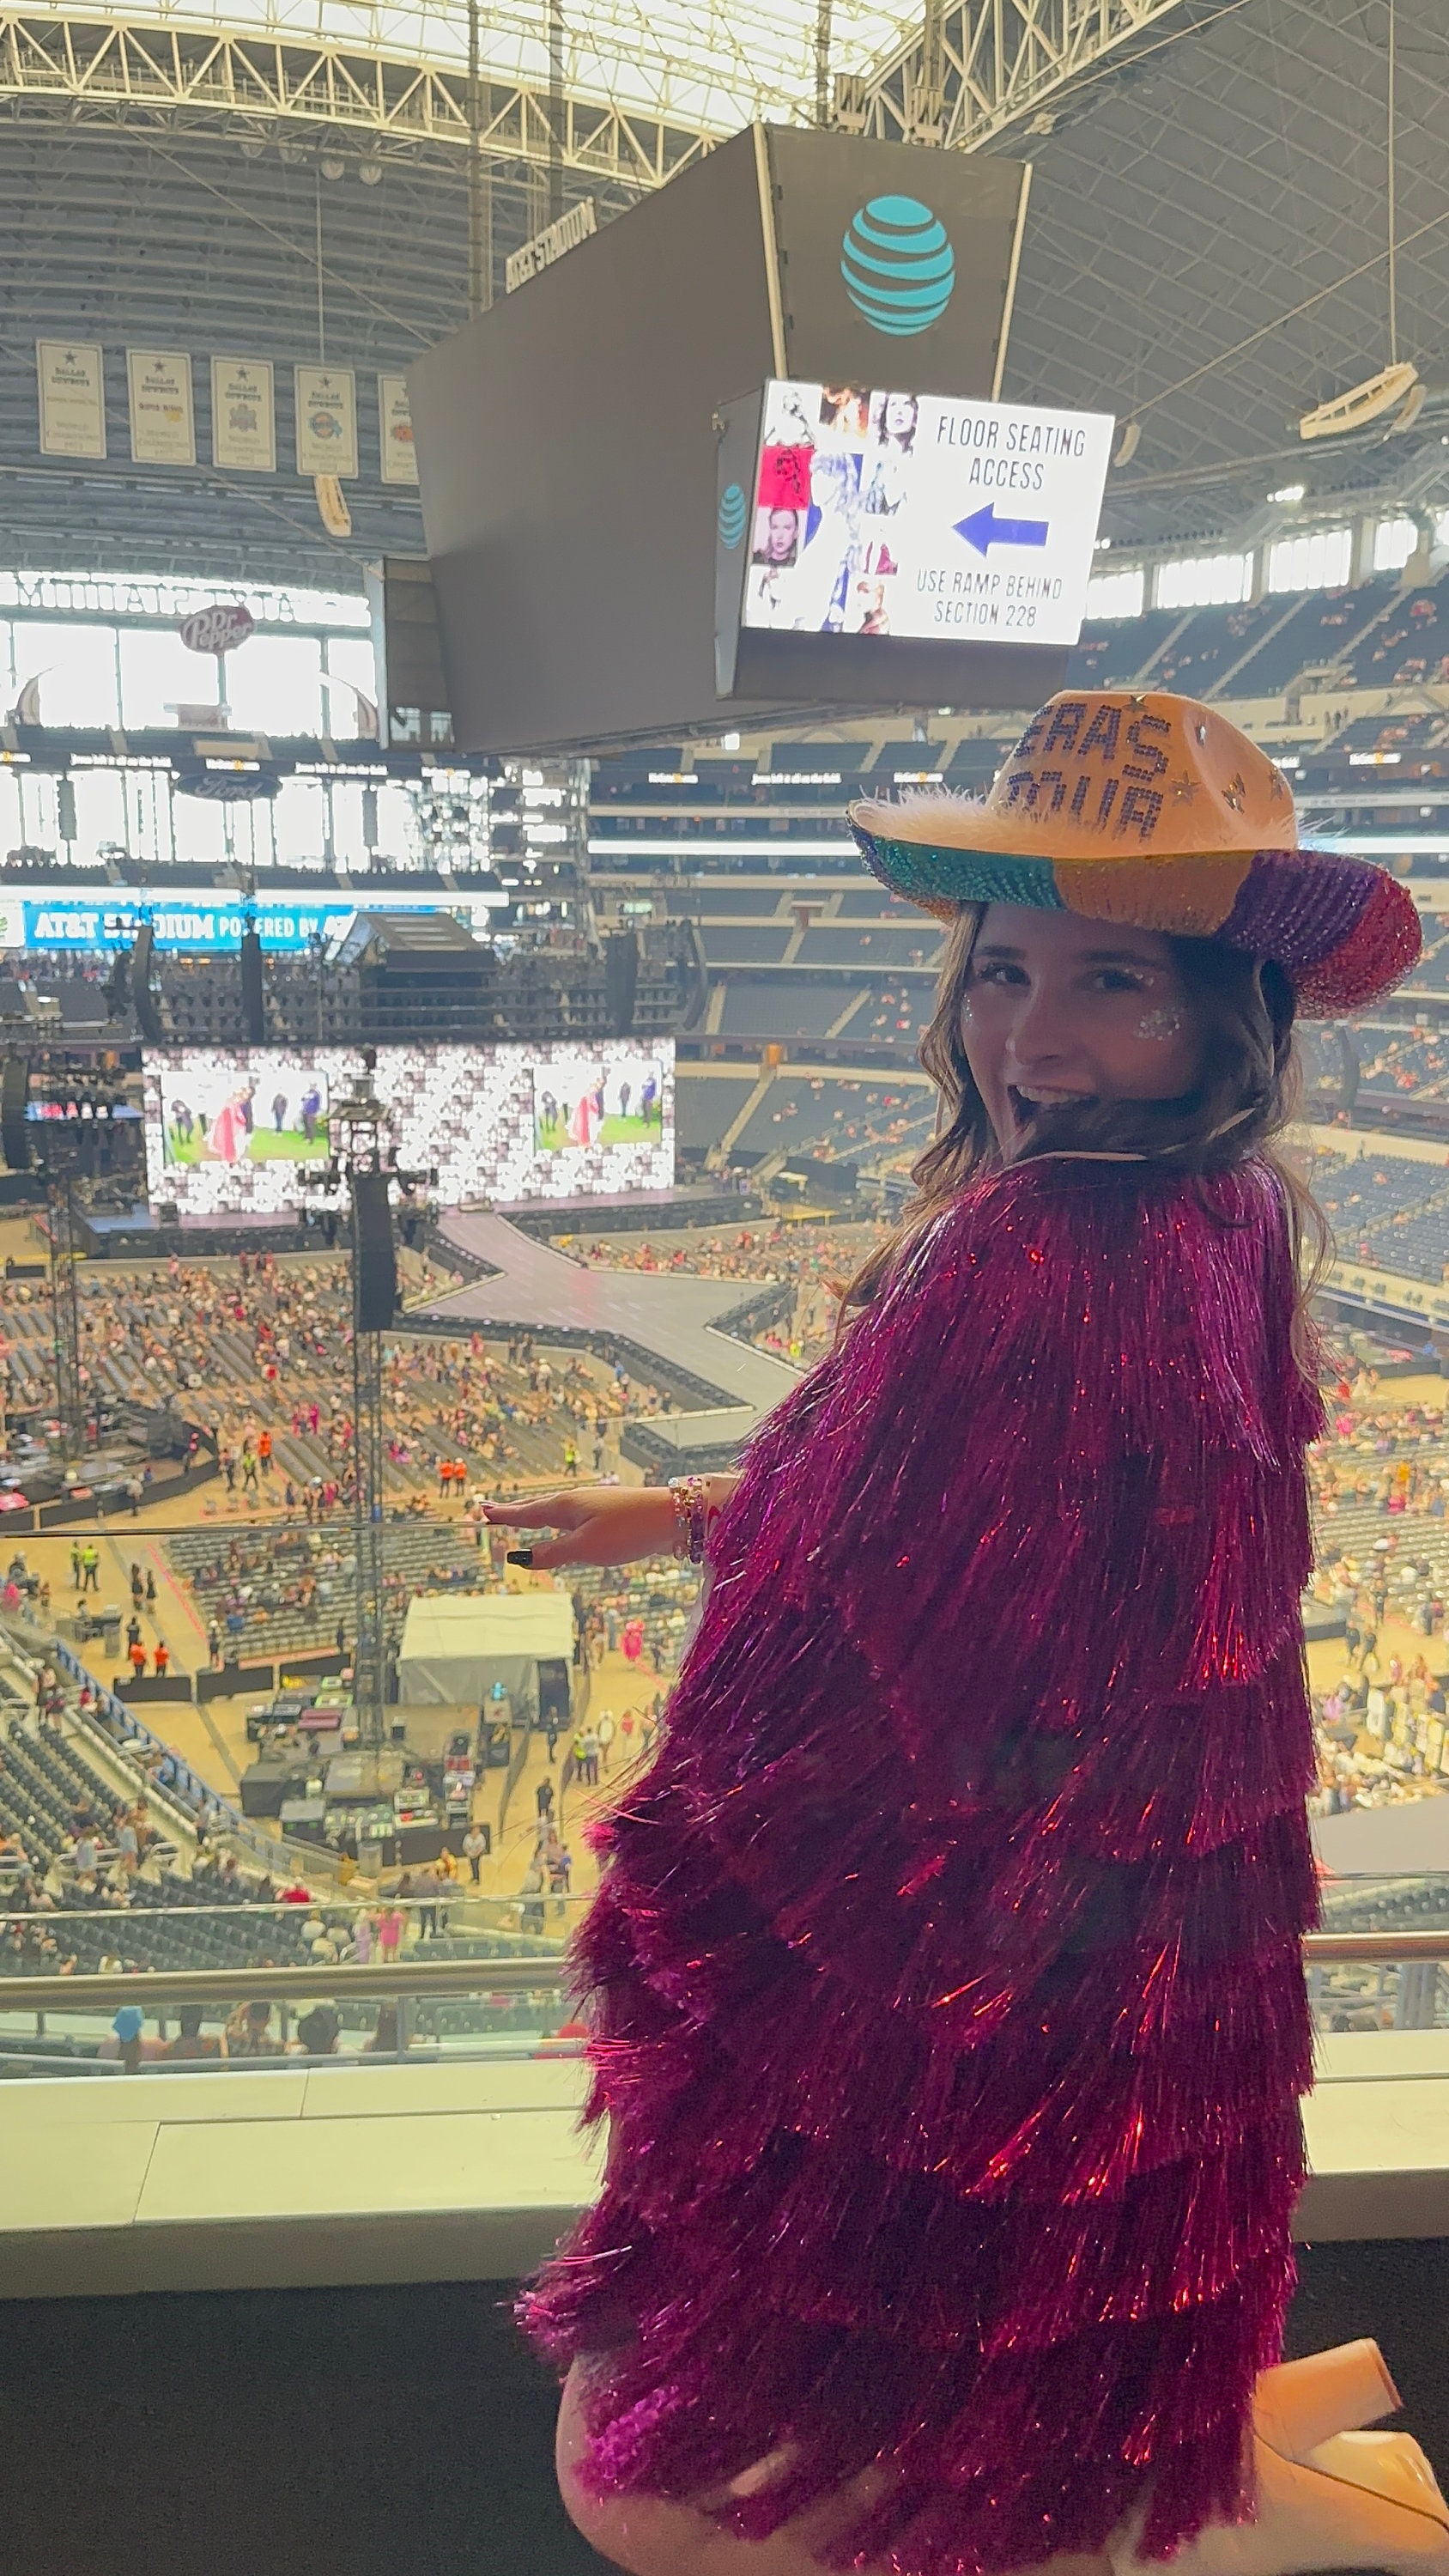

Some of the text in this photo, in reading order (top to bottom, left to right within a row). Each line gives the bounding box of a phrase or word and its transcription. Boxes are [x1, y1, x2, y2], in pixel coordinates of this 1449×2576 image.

[533, 196, 598, 273] STADIUM
[937, 416, 1086, 457] FLOOR SEATING
[969, 457, 1045, 490] ACCESS
[917, 568, 1063, 600] USE RAMP BEHIND
[211, 610, 238, 631] Dr
[934, 600, 1038, 628] SECTION 228
[184, 613, 252, 650] Pepper
[1014, 702, 1172, 782] ERAS
[194, 775, 264, 801] Ford
[1007, 770, 1164, 843] TOUR
[34, 912, 100, 939] AT&T
[103, 912, 215, 940] STDIUM
